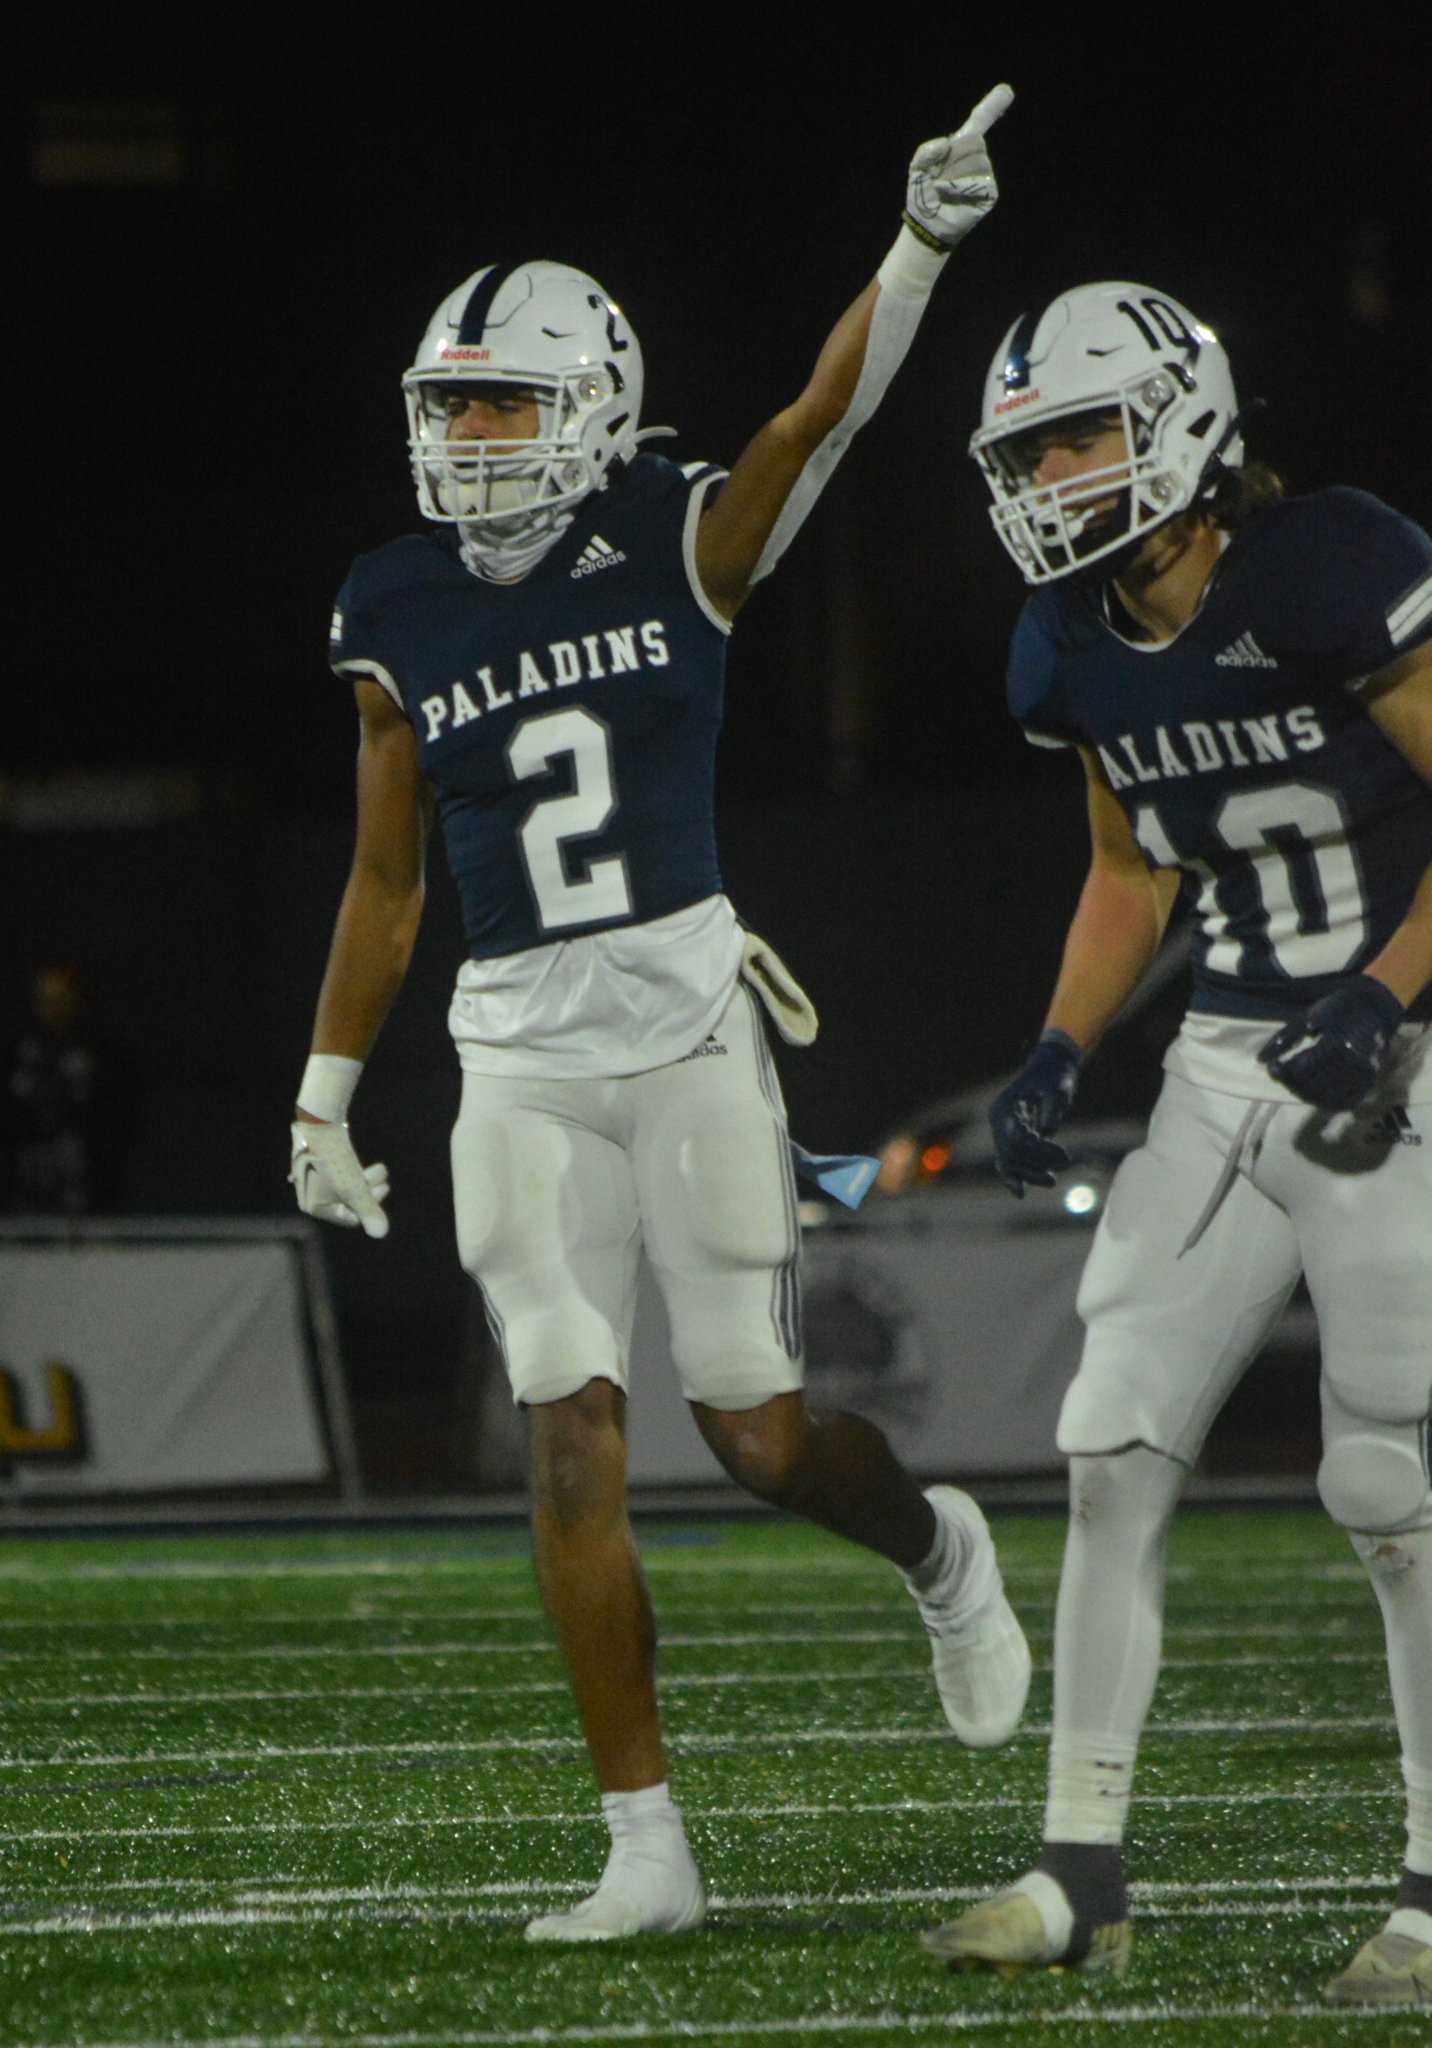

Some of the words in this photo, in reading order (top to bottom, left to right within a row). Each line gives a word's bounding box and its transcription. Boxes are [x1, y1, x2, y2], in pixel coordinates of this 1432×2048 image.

[440, 348, 490, 361] Riddell
[571, 549, 626, 579] adidas
[420, 619, 669, 743] PALADINS
[1215, 653, 1277, 670] adidas
[506, 706, 632, 931] 2
[1134, 784, 1366, 978] 10
